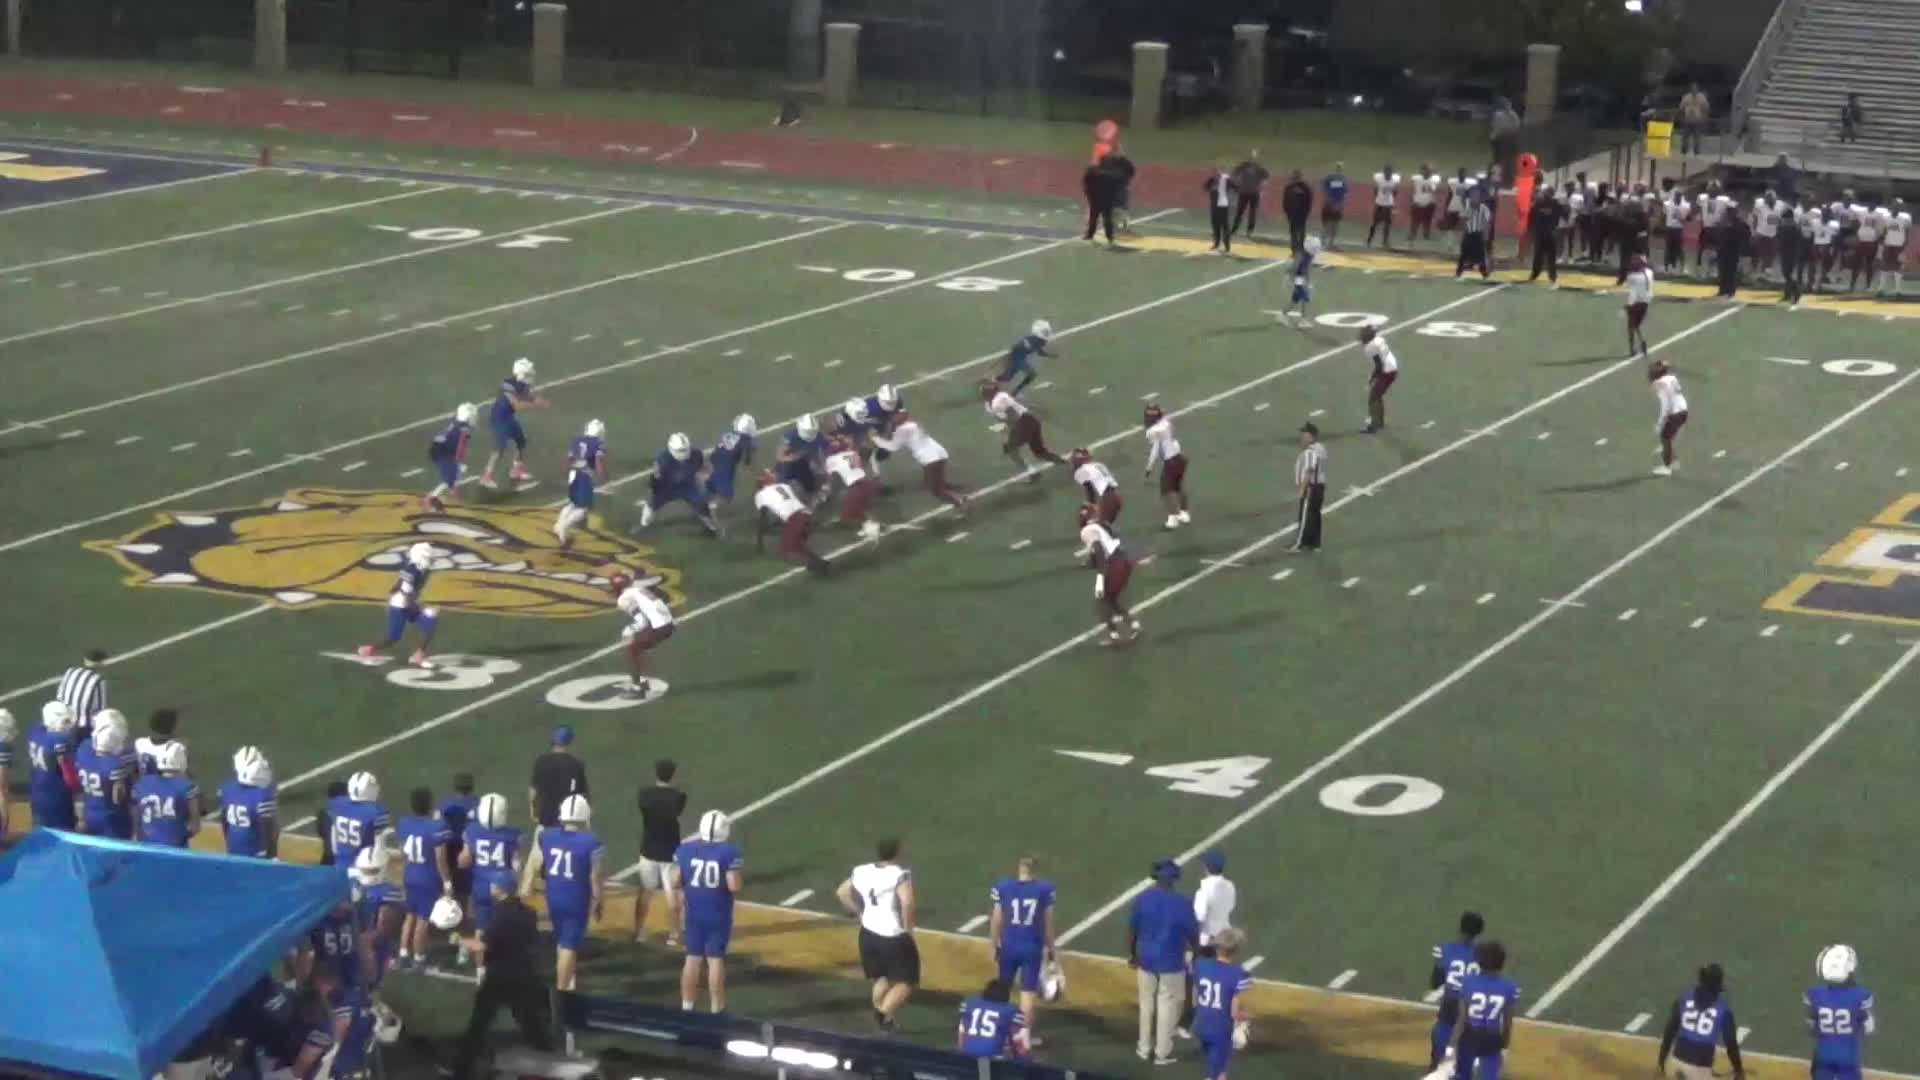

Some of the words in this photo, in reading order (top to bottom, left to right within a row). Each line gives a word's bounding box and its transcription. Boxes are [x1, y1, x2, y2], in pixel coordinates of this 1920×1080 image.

[226, 804, 251, 828] 45
[336, 815, 362, 848] 55
[403, 834, 425, 864] 41
[475, 839, 505, 868] 54
[549, 847, 574, 878] 71
[690, 858, 720, 889] 70
[1010, 897, 1038, 926] 17
[1199, 979, 1222, 1009] 31
[1468, 992, 1505, 1020] 27
[967, 1007, 999, 1038] 15
[1818, 1007, 1853, 1034] 22
